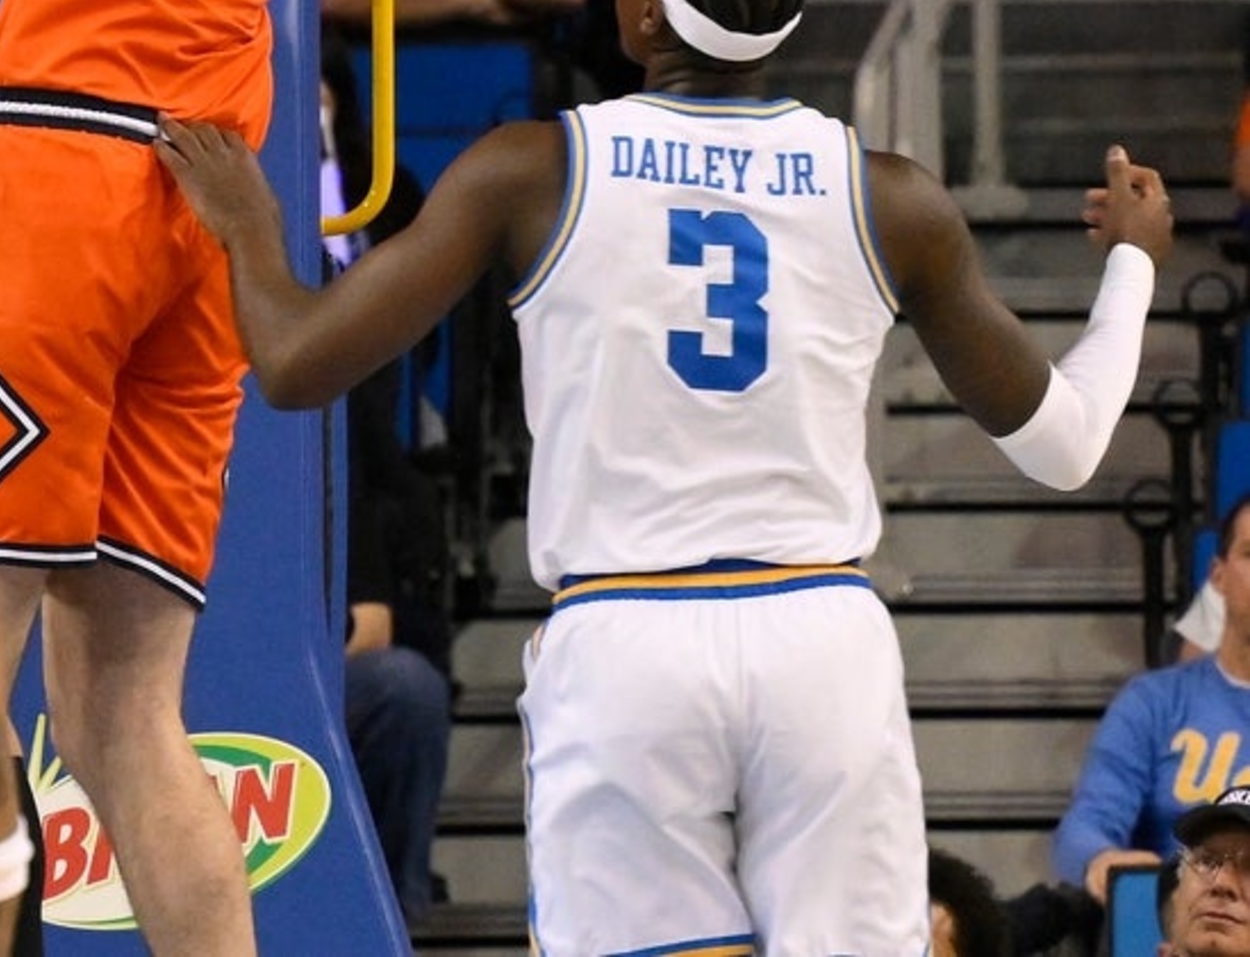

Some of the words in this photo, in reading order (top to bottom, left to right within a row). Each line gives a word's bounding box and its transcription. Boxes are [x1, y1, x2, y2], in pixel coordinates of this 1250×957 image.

[610, 135, 753, 194] DAILEY
[766, 152, 828, 196] JR.
[667, 207, 769, 392] 3
